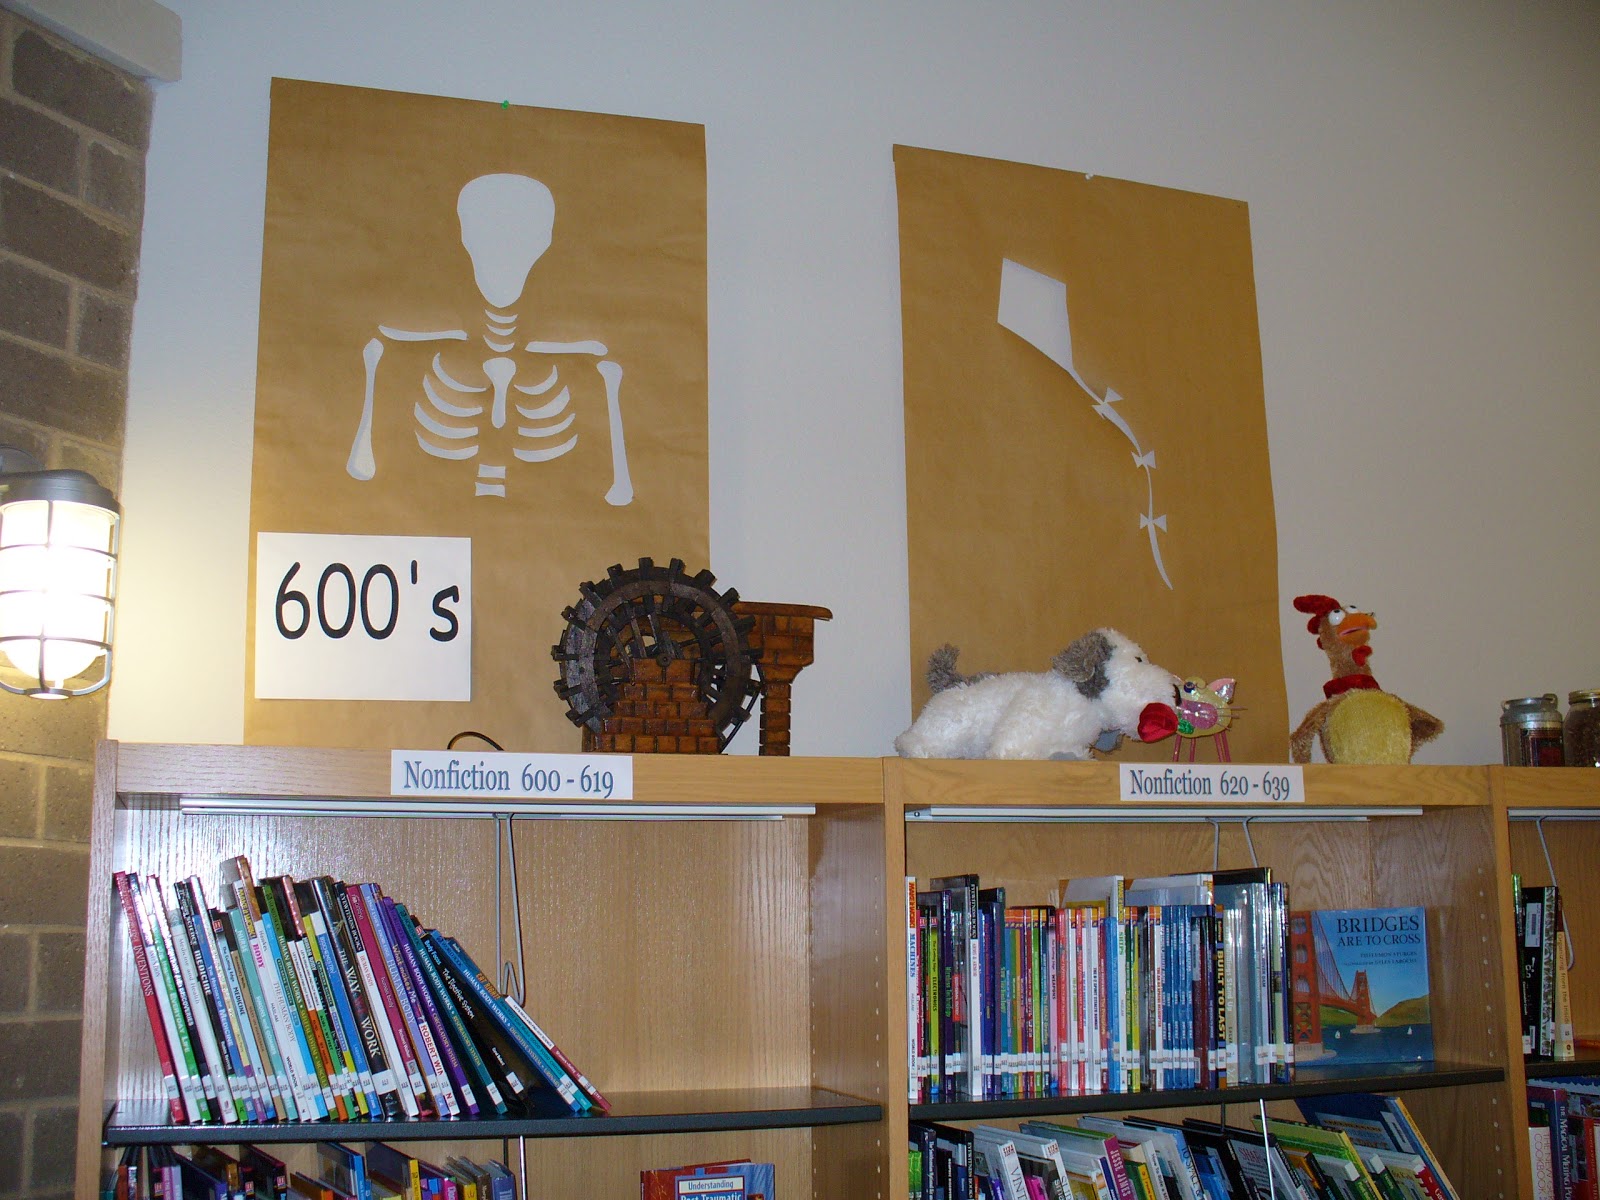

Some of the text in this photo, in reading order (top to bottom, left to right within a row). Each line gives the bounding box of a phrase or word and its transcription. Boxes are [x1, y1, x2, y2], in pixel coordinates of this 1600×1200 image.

[275, 560, 460, 642] 600's
[403, 760, 510, 791] Nonfiction
[521, 763, 561, 792] 600
[580, 764, 614, 799] 619
[1130, 768, 1212, 795] Nonfiction
[1220, 770, 1248, 796] 620
[1263, 771, 1290, 801] 639
[235, 929, 248, 953] NURSE
[1337, 915, 1420, 934] BRIDGES
[1337, 933, 1422, 947] ARE TO CROSS
[177, 937, 190, 966] Medicine
[252, 943, 264, 969] BODY
[422, 938, 434, 952] Body
[1556, 933, 1565, 971] Organizing
[133, 944, 153, 996] INVENTIONS
[277, 934, 290, 960] HUMAN
[285, 960, 296, 980] BODY
[291, 980, 302, 1004] WORKS
[402, 943, 417, 967] HUMAN
[412, 967, 425, 986] BODY
[420, 985, 434, 1008] WORKS
[418, 948, 434, 972] HUMAN
[429, 971, 443, 990] BODY
[438, 988, 453, 1011] WORKS
[440, 967, 452, 981] The
[1216, 950, 1224, 985] BUILT
[232, 986, 245, 1016] MEDICINE
[272, 981, 282, 998] THE
[337, 947, 349, 965] THE
[343, 964, 361, 993] WAY
[358, 1015, 382, 1058] WORK
[385, 958, 407, 997] HUMAN
[399, 997, 417, 1025] BODY
[445, 977, 466, 1003] Digestive
[462, 968, 481, 990] HUMAN
[478, 988, 494, 1006] BODY
[490, 1003, 509, 1024] WORKS
[1217, 988, 1224, 1005] TO
[459, 999, 476, 1019] System
[419, 1024, 438, 1058] ROBERT
[1542, 1134, 1550, 1150] THE
[1558, 1118, 1570, 1152] MAGICAL
[1108, 1148, 1132, 1197] JESSE JAMES
[1533, 1133, 1546, 1195] COOKBOOK
[1561, 1154, 1571, 1185] MELTING
[688, 1180, 733, 1191] Understanding
